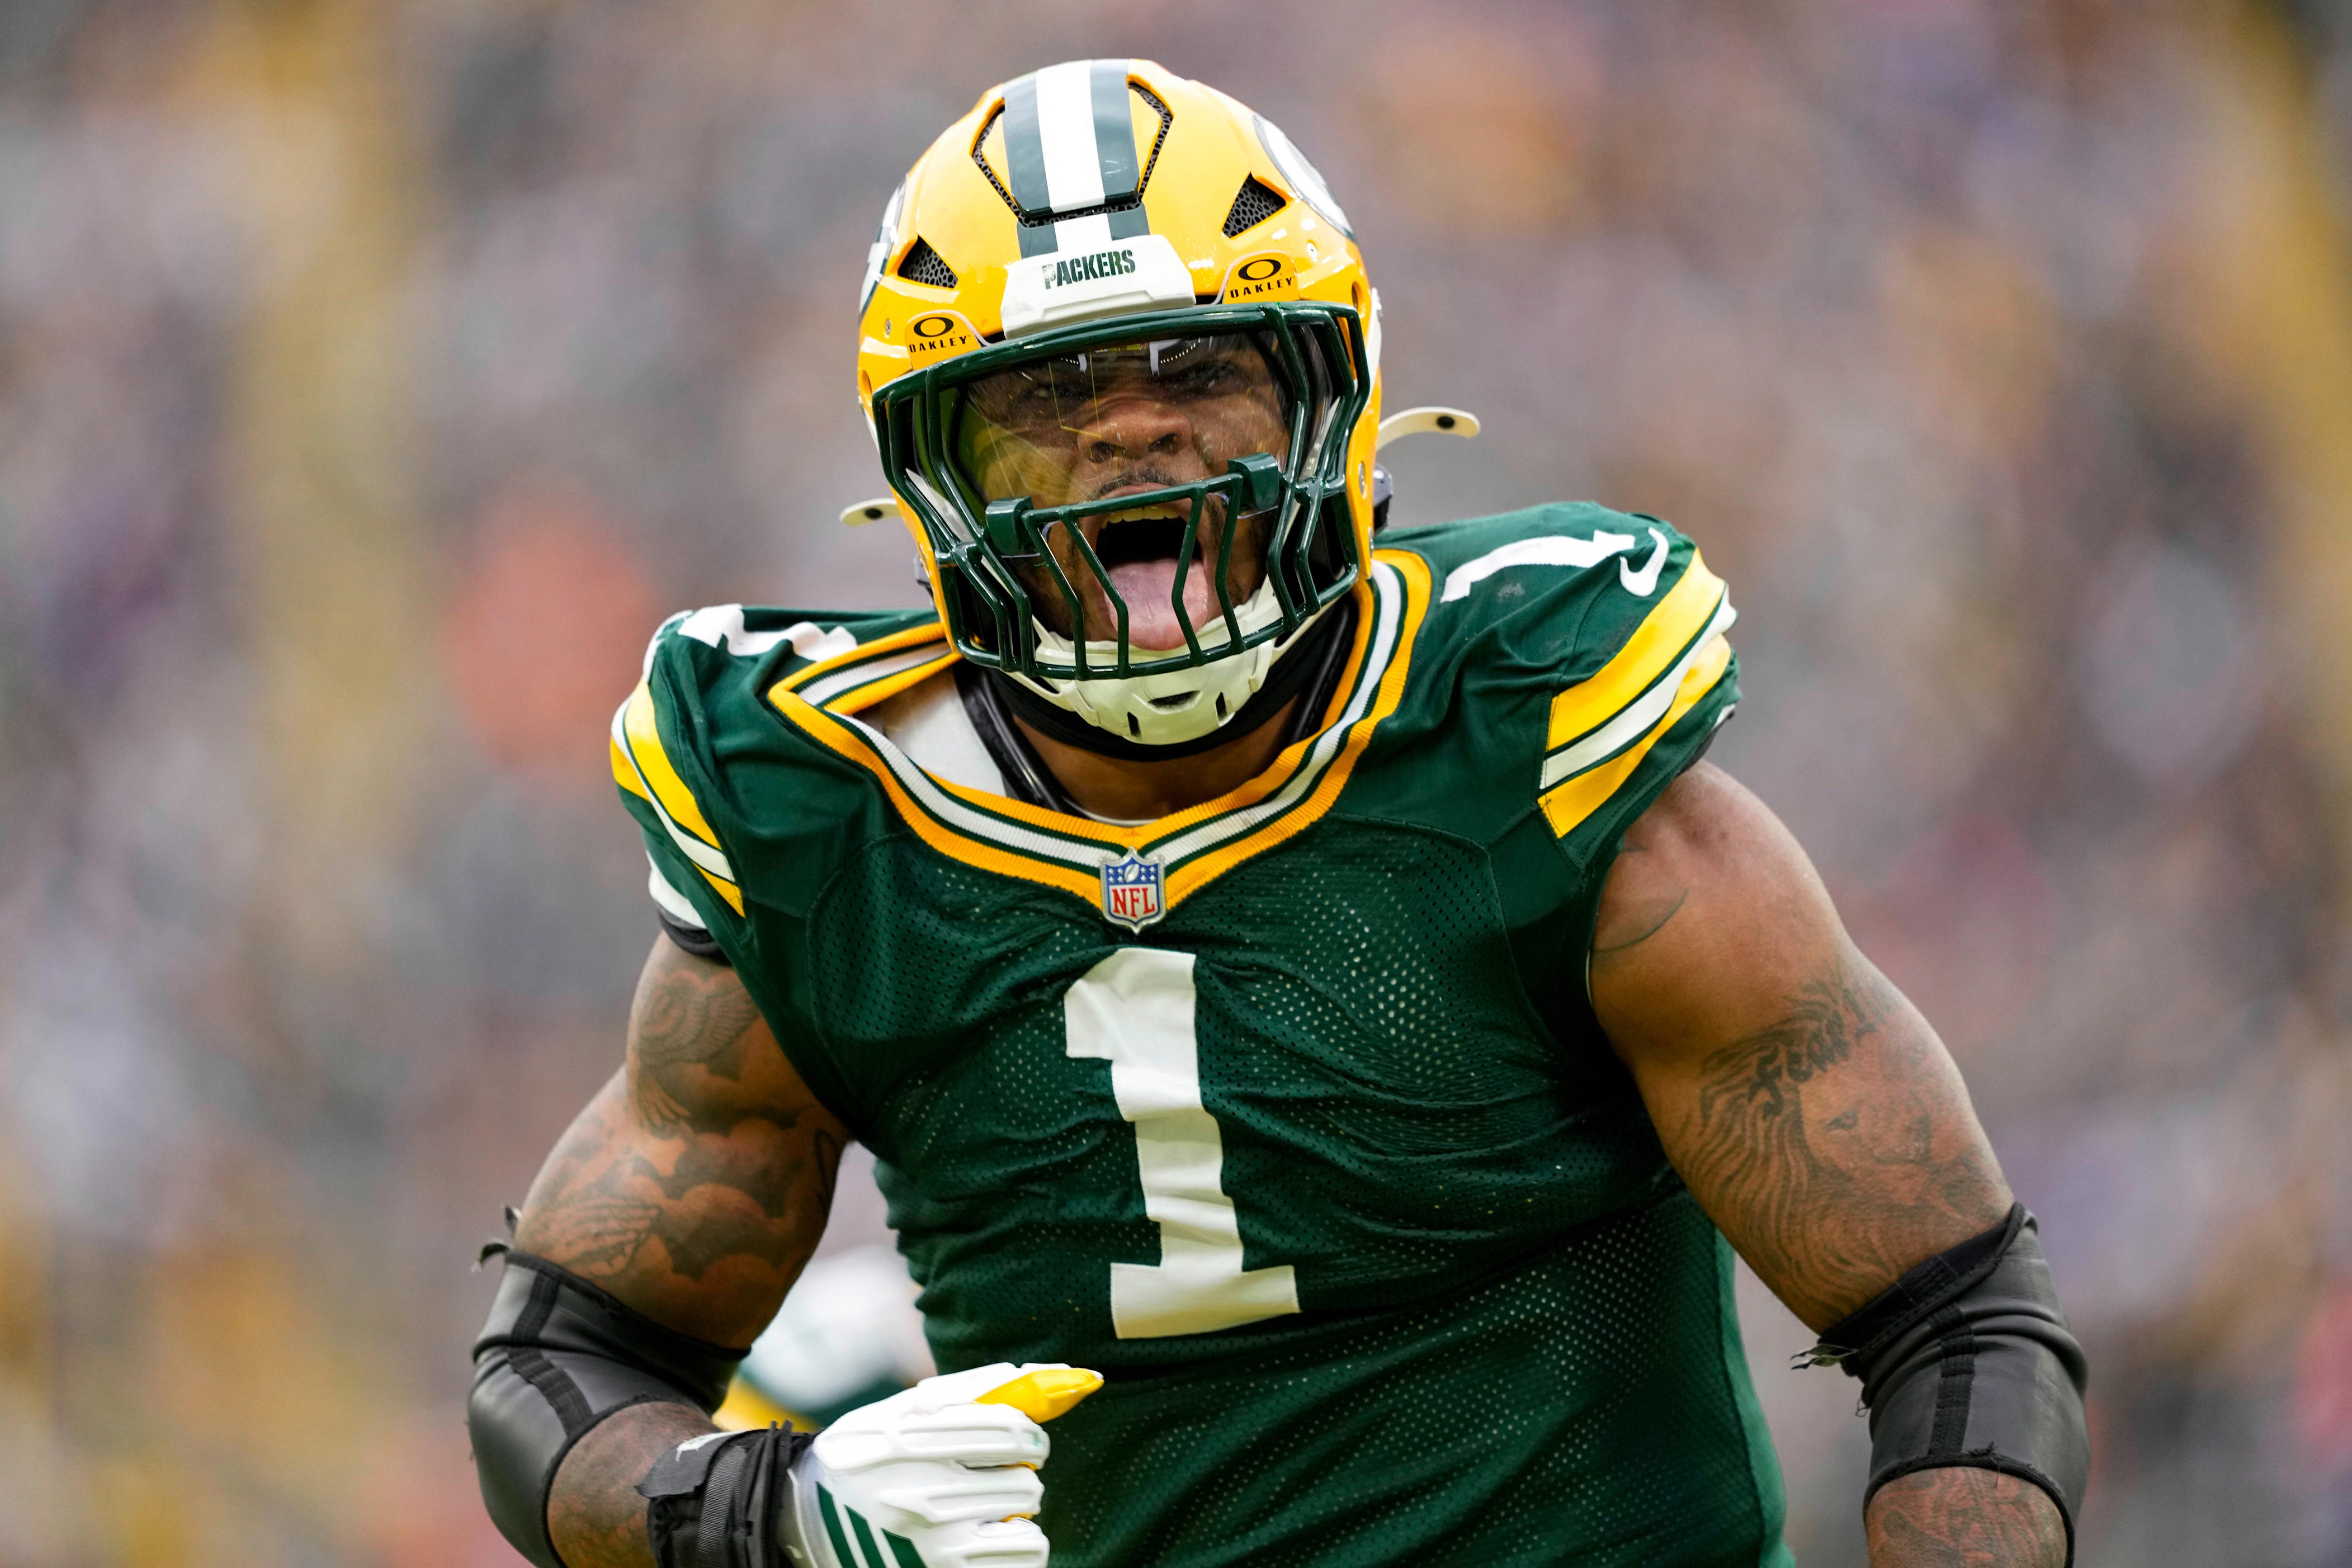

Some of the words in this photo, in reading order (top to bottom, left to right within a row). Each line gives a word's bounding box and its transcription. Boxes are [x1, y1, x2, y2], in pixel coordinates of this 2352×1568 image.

[1042, 249, 1136, 290] PACKERS
[1230, 277, 1292, 299] OAKLEY
[909, 336, 967, 353] OAKLEY
[1111, 887, 1156, 919] NFL
[1064, 947, 1301, 1339] 1
